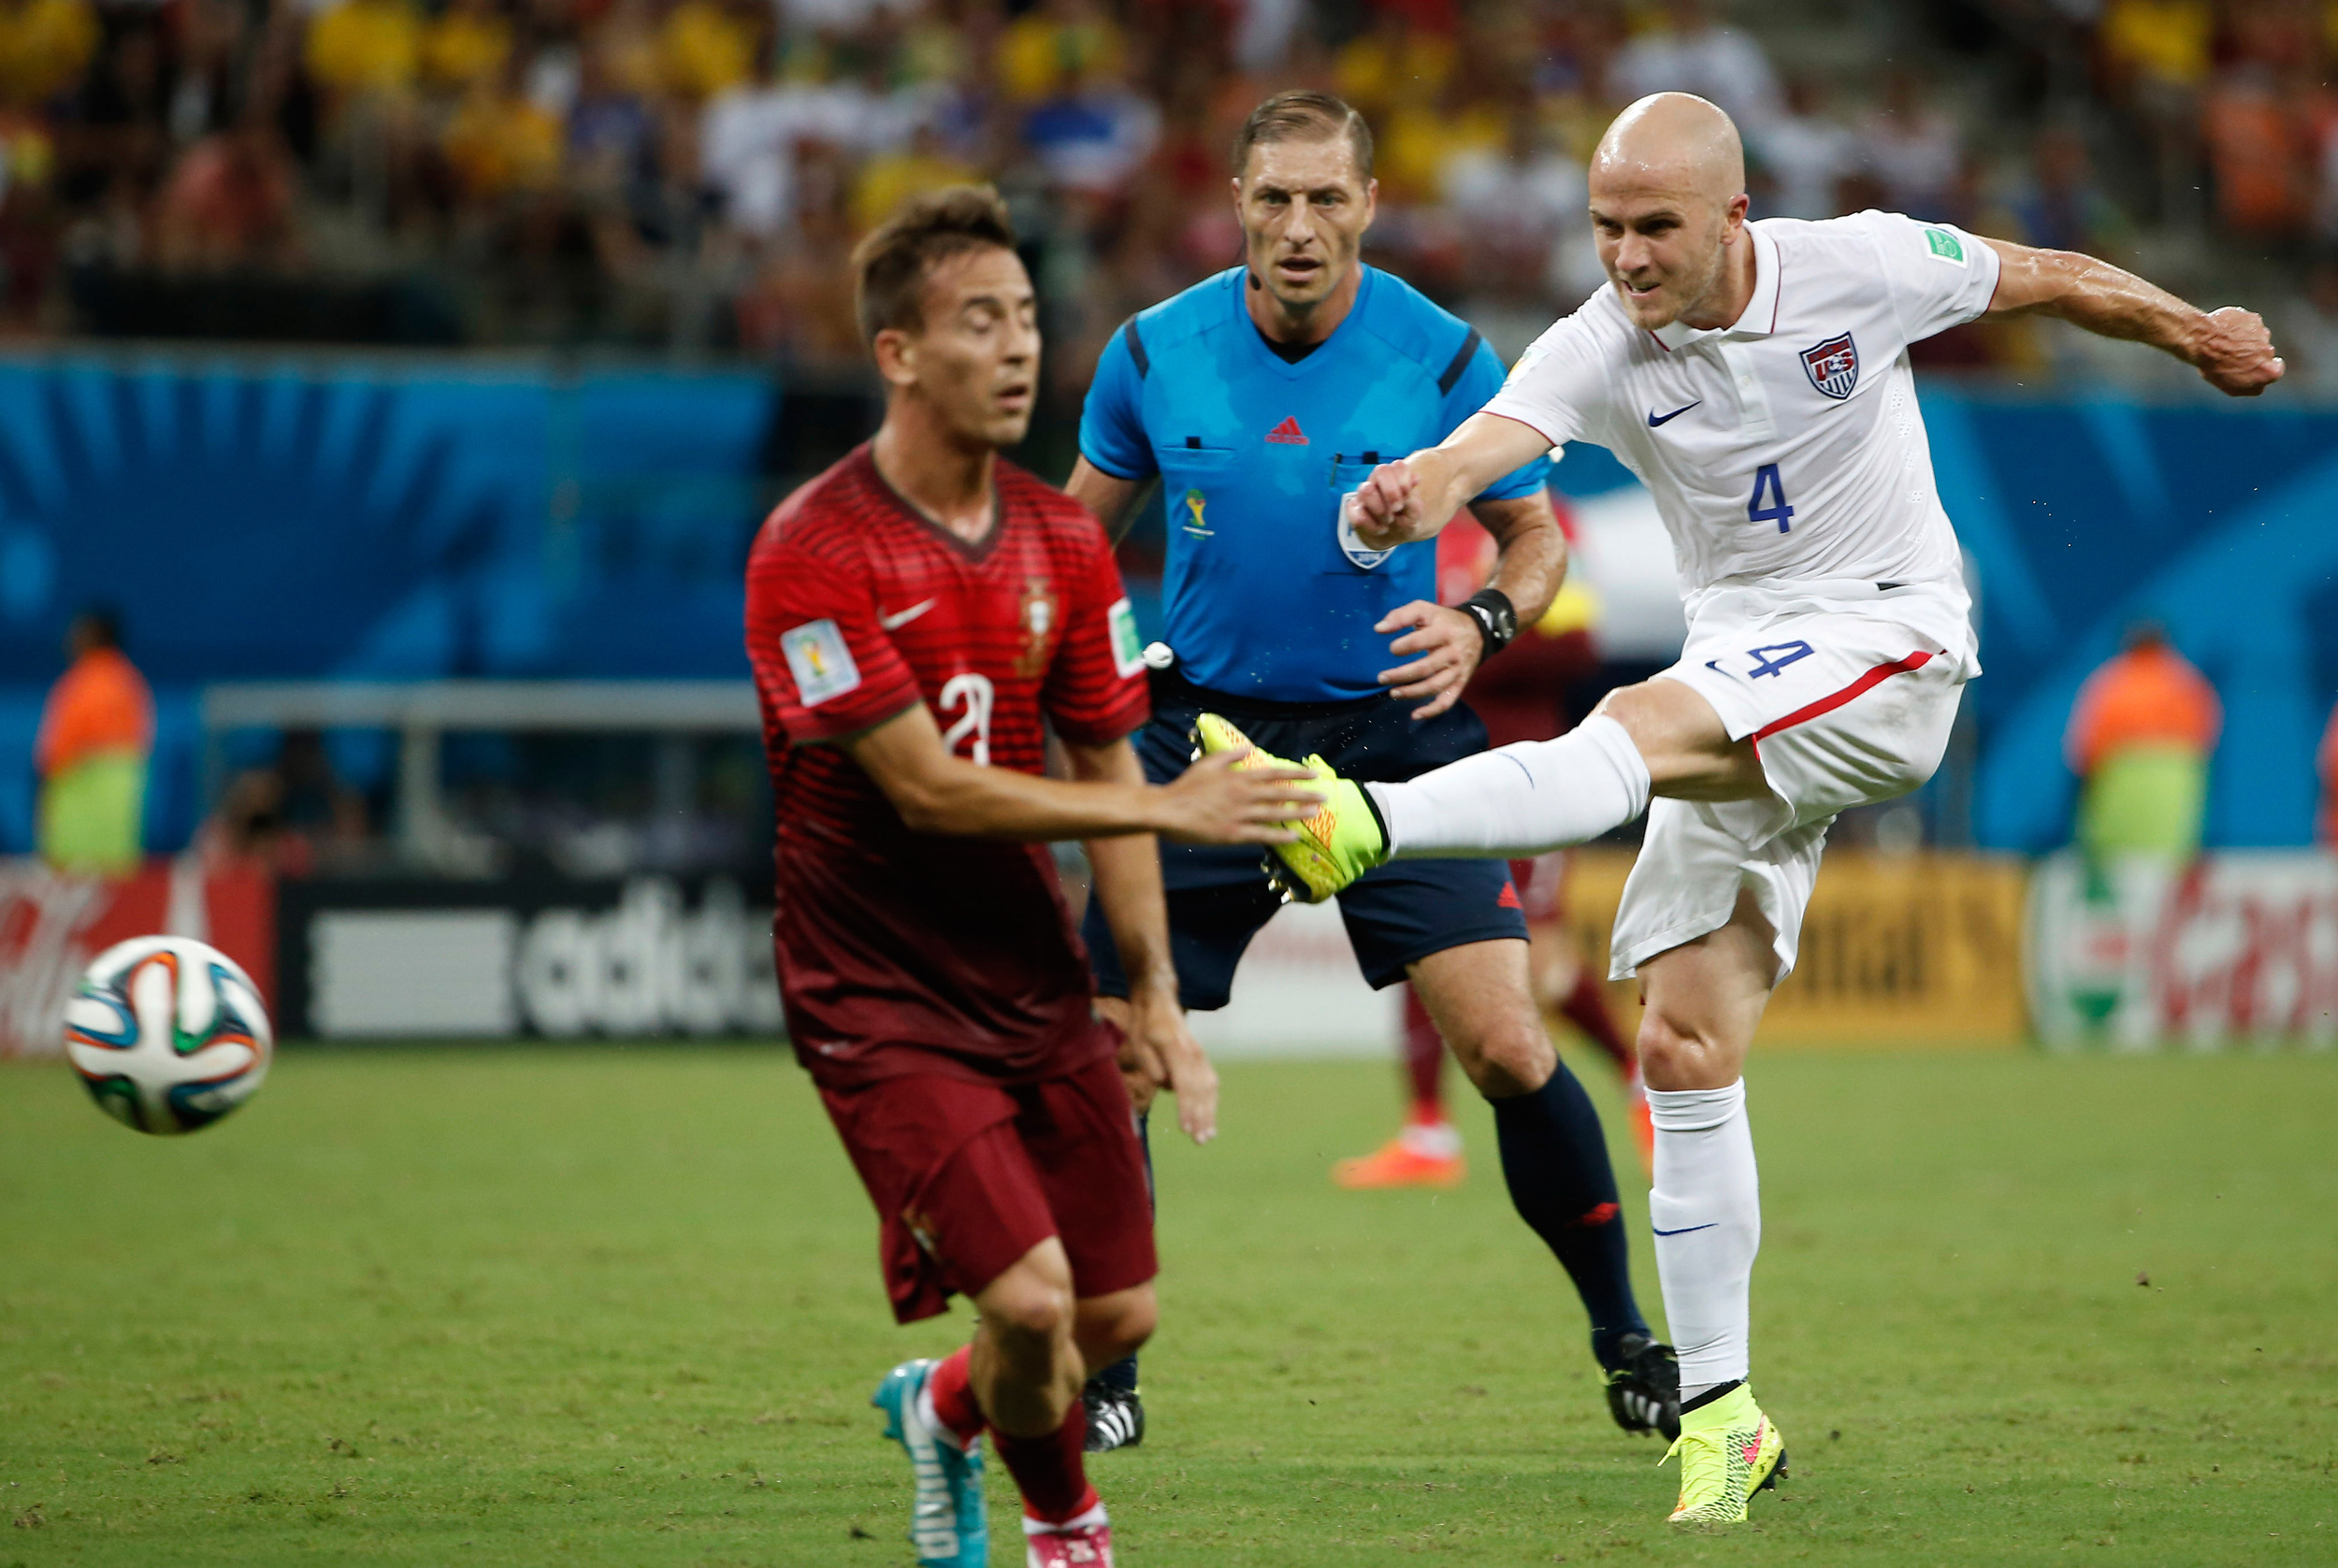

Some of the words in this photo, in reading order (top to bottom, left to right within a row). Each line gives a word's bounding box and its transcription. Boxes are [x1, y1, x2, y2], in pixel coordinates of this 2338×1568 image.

[1747, 463, 1795, 534] 4
[1745, 640, 1815, 679] 4
[516, 877, 784, 1033] adid
